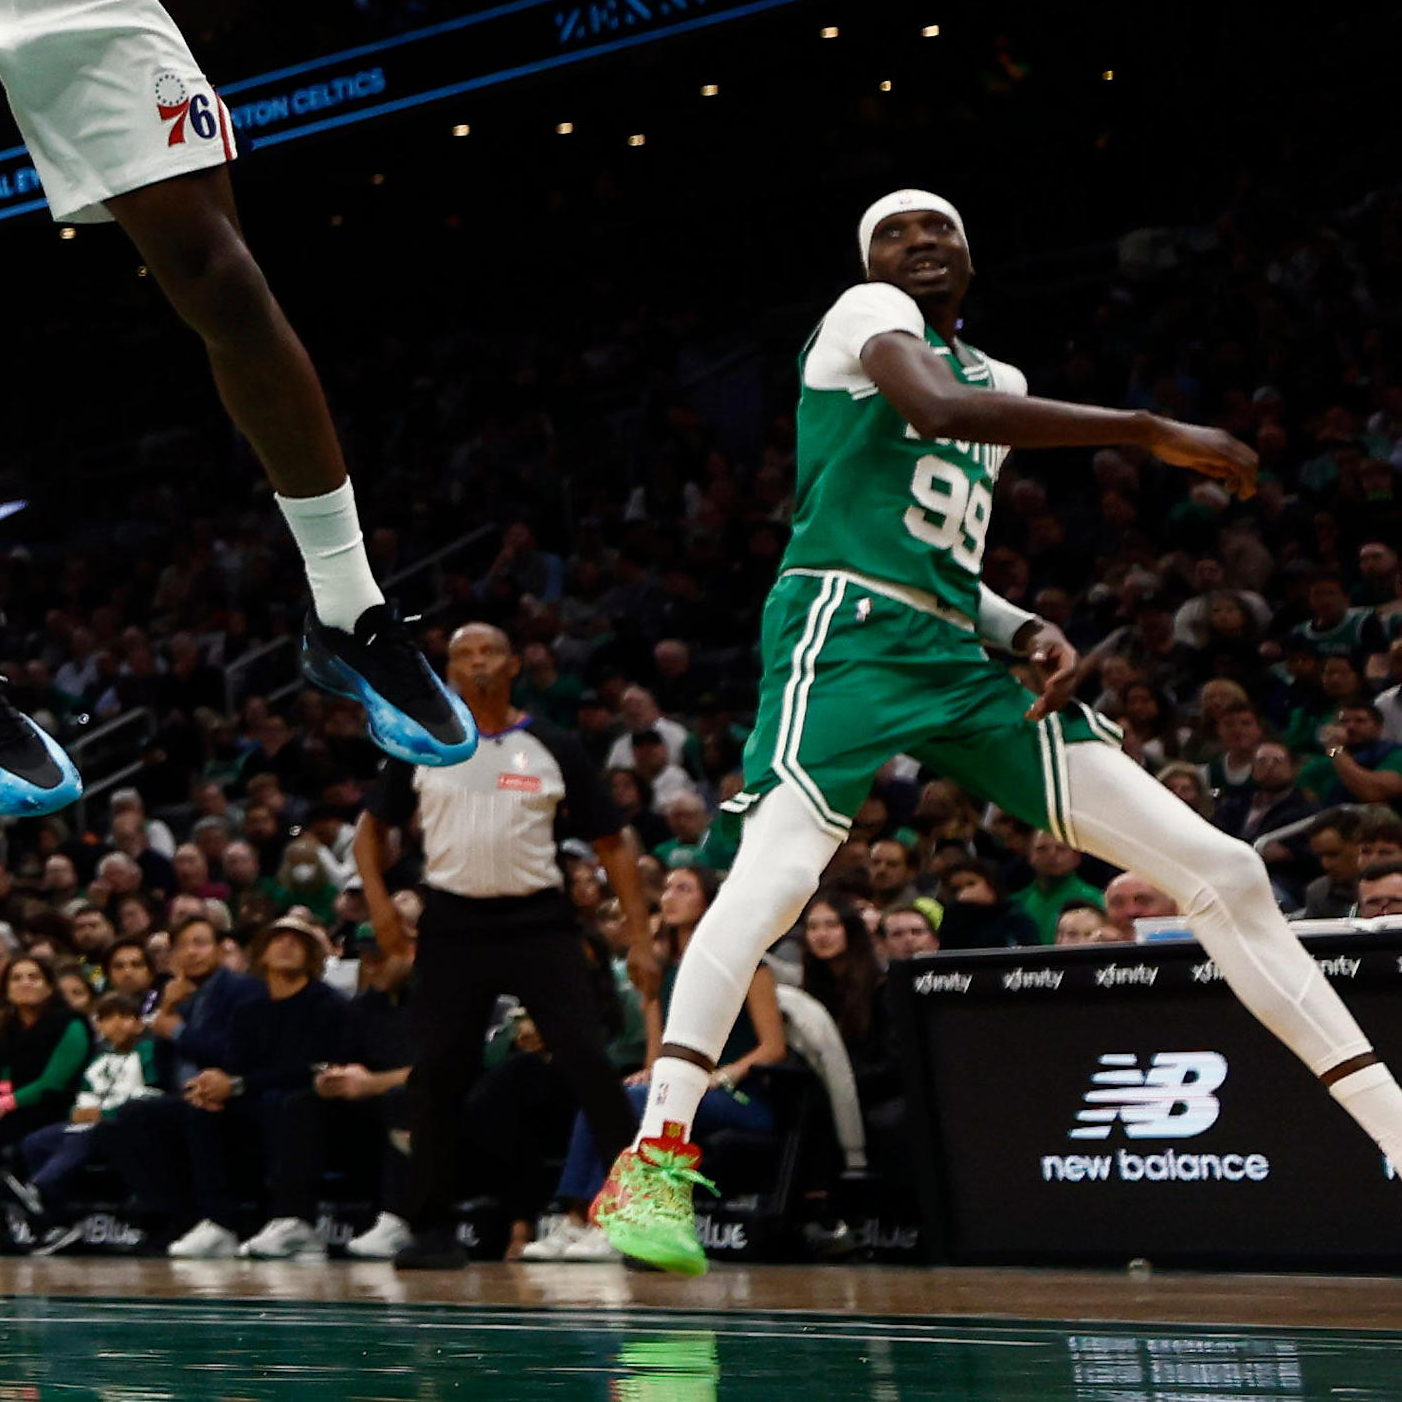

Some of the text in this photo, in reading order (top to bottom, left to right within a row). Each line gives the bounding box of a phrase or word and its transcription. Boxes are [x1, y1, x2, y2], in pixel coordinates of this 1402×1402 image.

[292, 66, 386, 116] CELTICS
[156, 93, 217, 148] 76
[902, 452, 992, 575] 99
[913, 971, 973, 995] xfinity
[1002, 967, 1064, 992] xfinity
[1094, 962, 1159, 988] xfinity
[1040, 1148, 1270, 1182] new balance
